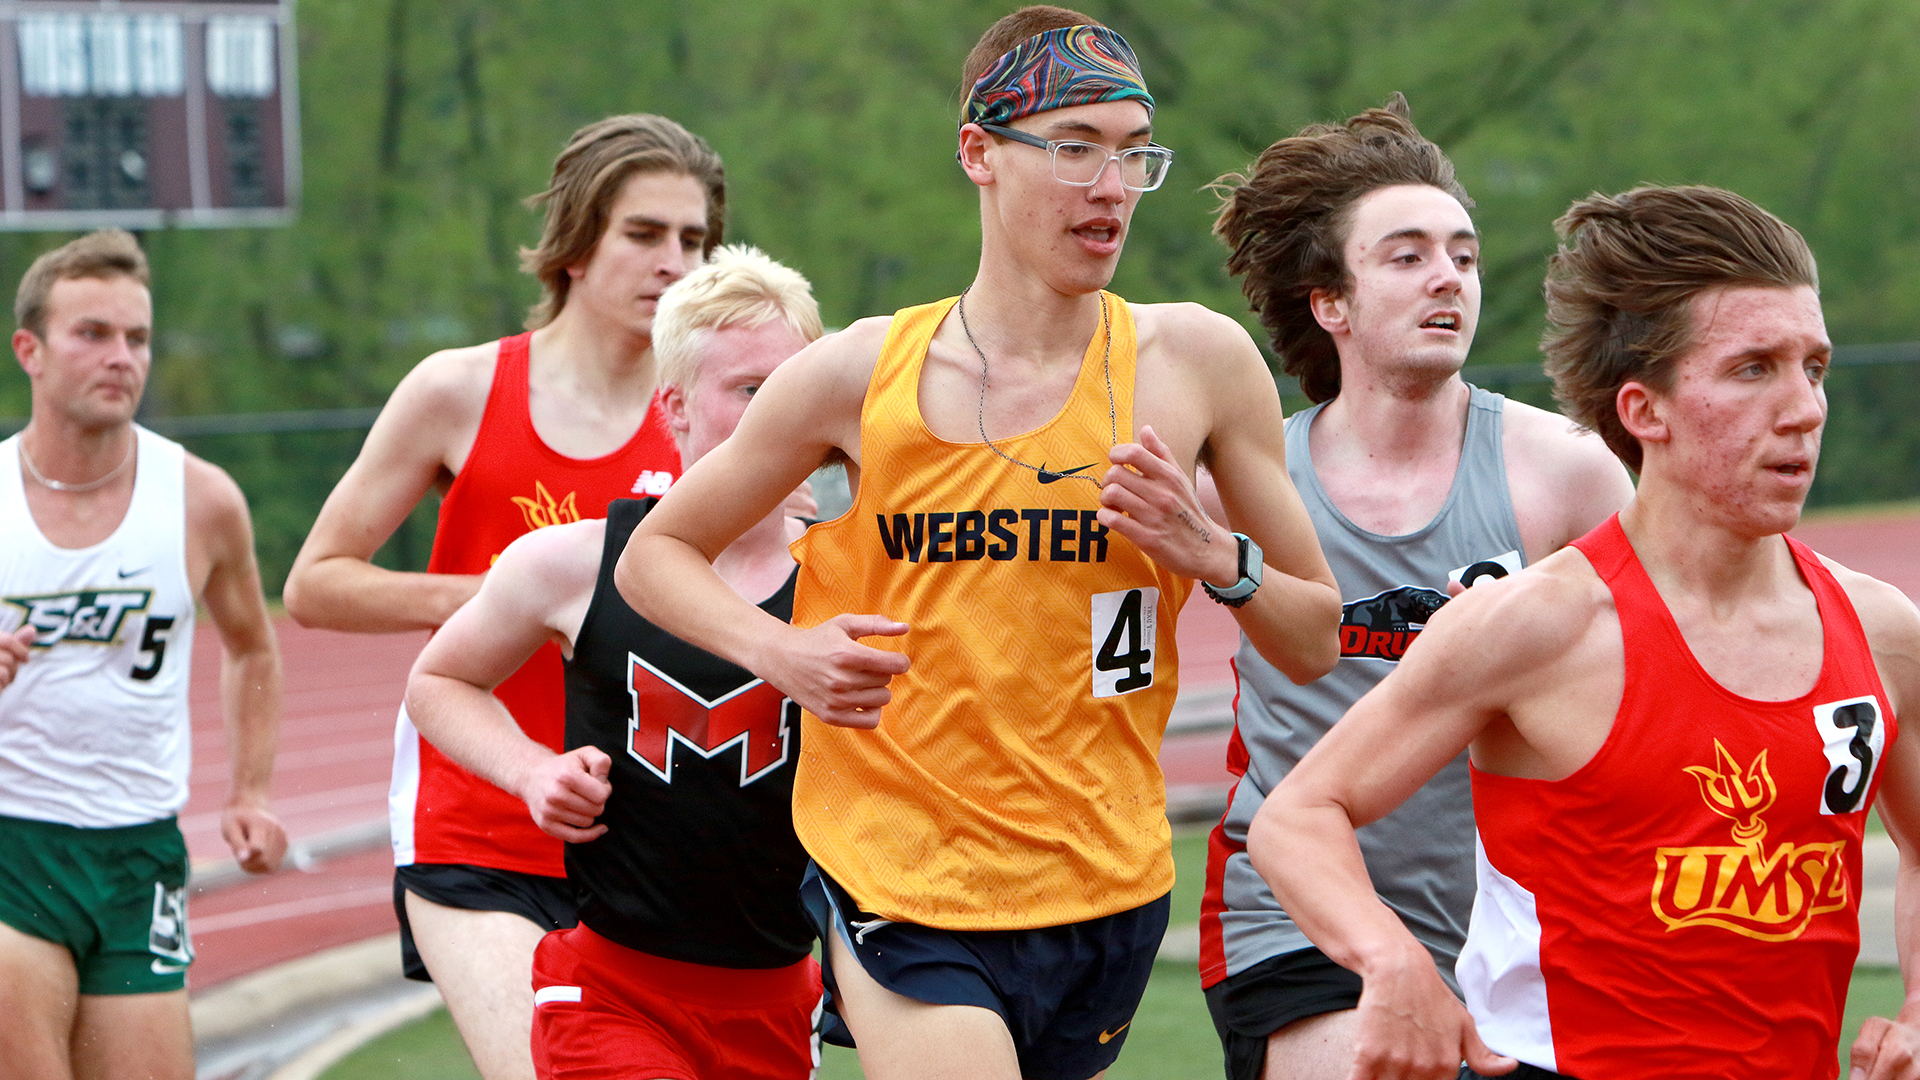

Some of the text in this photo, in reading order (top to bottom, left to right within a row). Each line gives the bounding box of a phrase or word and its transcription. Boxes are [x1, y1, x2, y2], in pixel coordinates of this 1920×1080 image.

[876, 508, 1110, 564] WEBSTER
[23, 592, 148, 645] S&T
[130, 614, 176, 681] 5
[1095, 588, 1152, 694] 4
[1339, 624, 1422, 658] DRU
[626, 651, 793, 787] M
[1824, 701, 1876, 815] 3
[1651, 839, 1848, 943] UMSL
